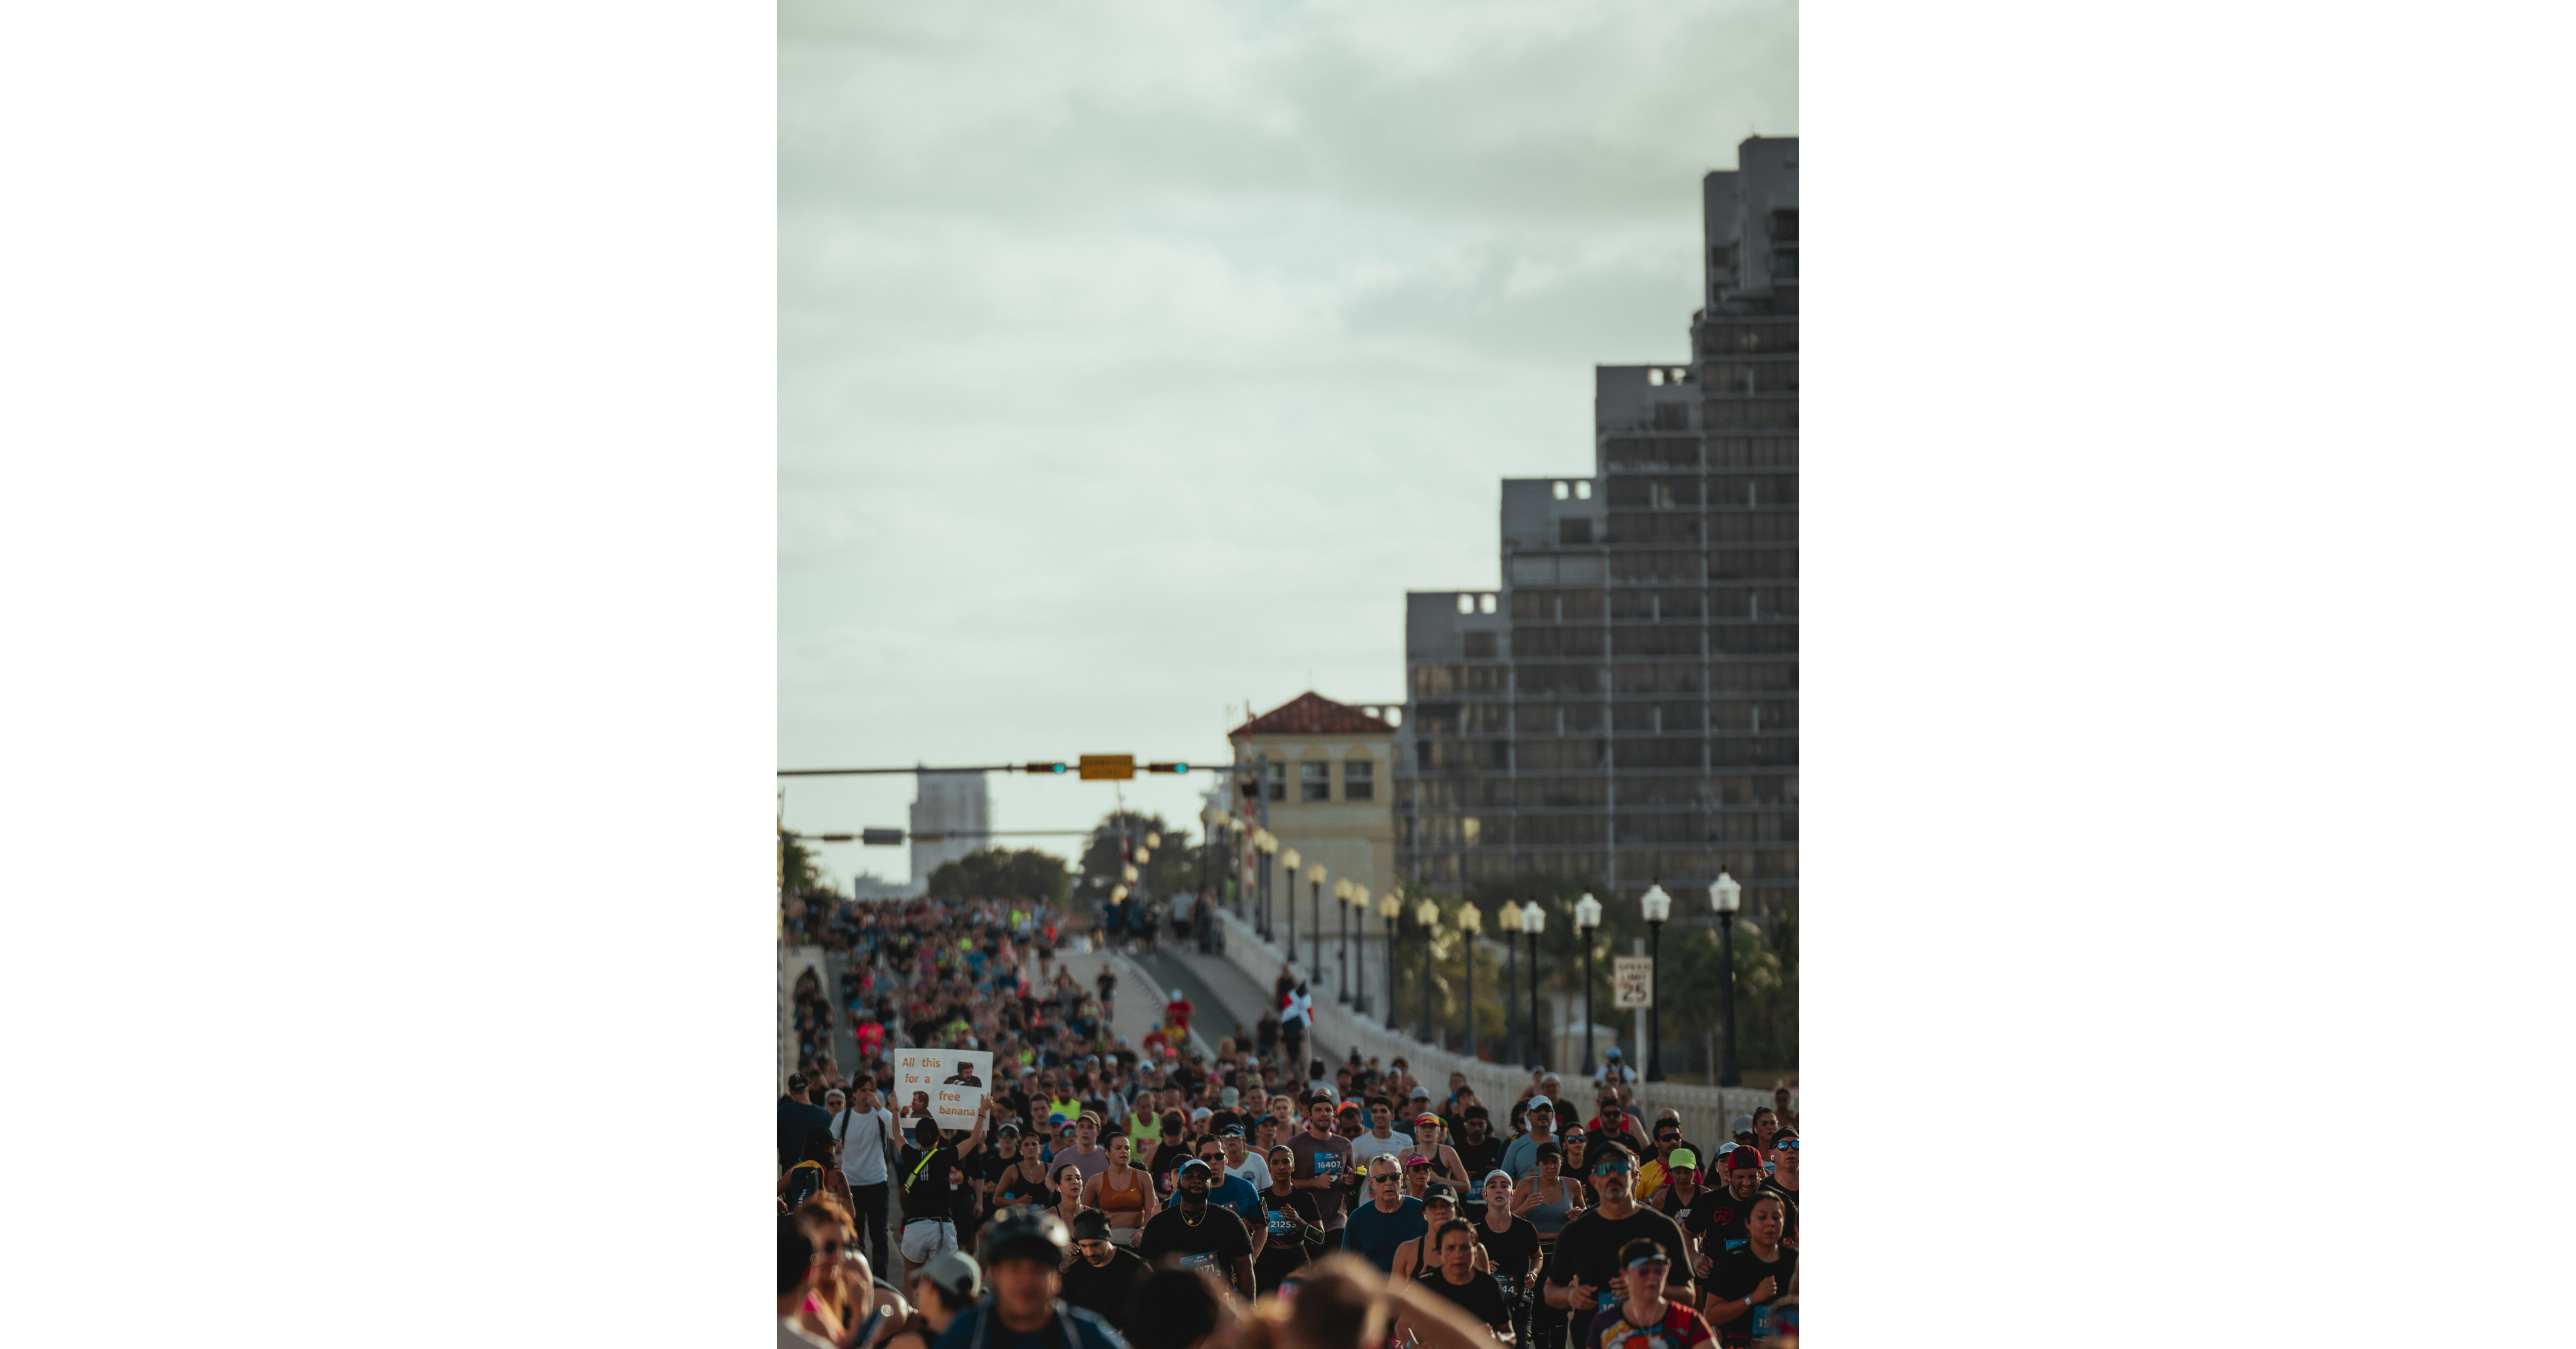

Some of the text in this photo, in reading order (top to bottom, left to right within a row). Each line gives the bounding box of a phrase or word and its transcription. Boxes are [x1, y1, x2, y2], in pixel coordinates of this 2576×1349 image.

[1623, 982, 1646, 1001] 25
[902, 1057, 940, 1068] All this
[905, 1073, 919, 1083] for
[939, 1090, 960, 1101] free
[939, 1105, 975, 1116] banana
